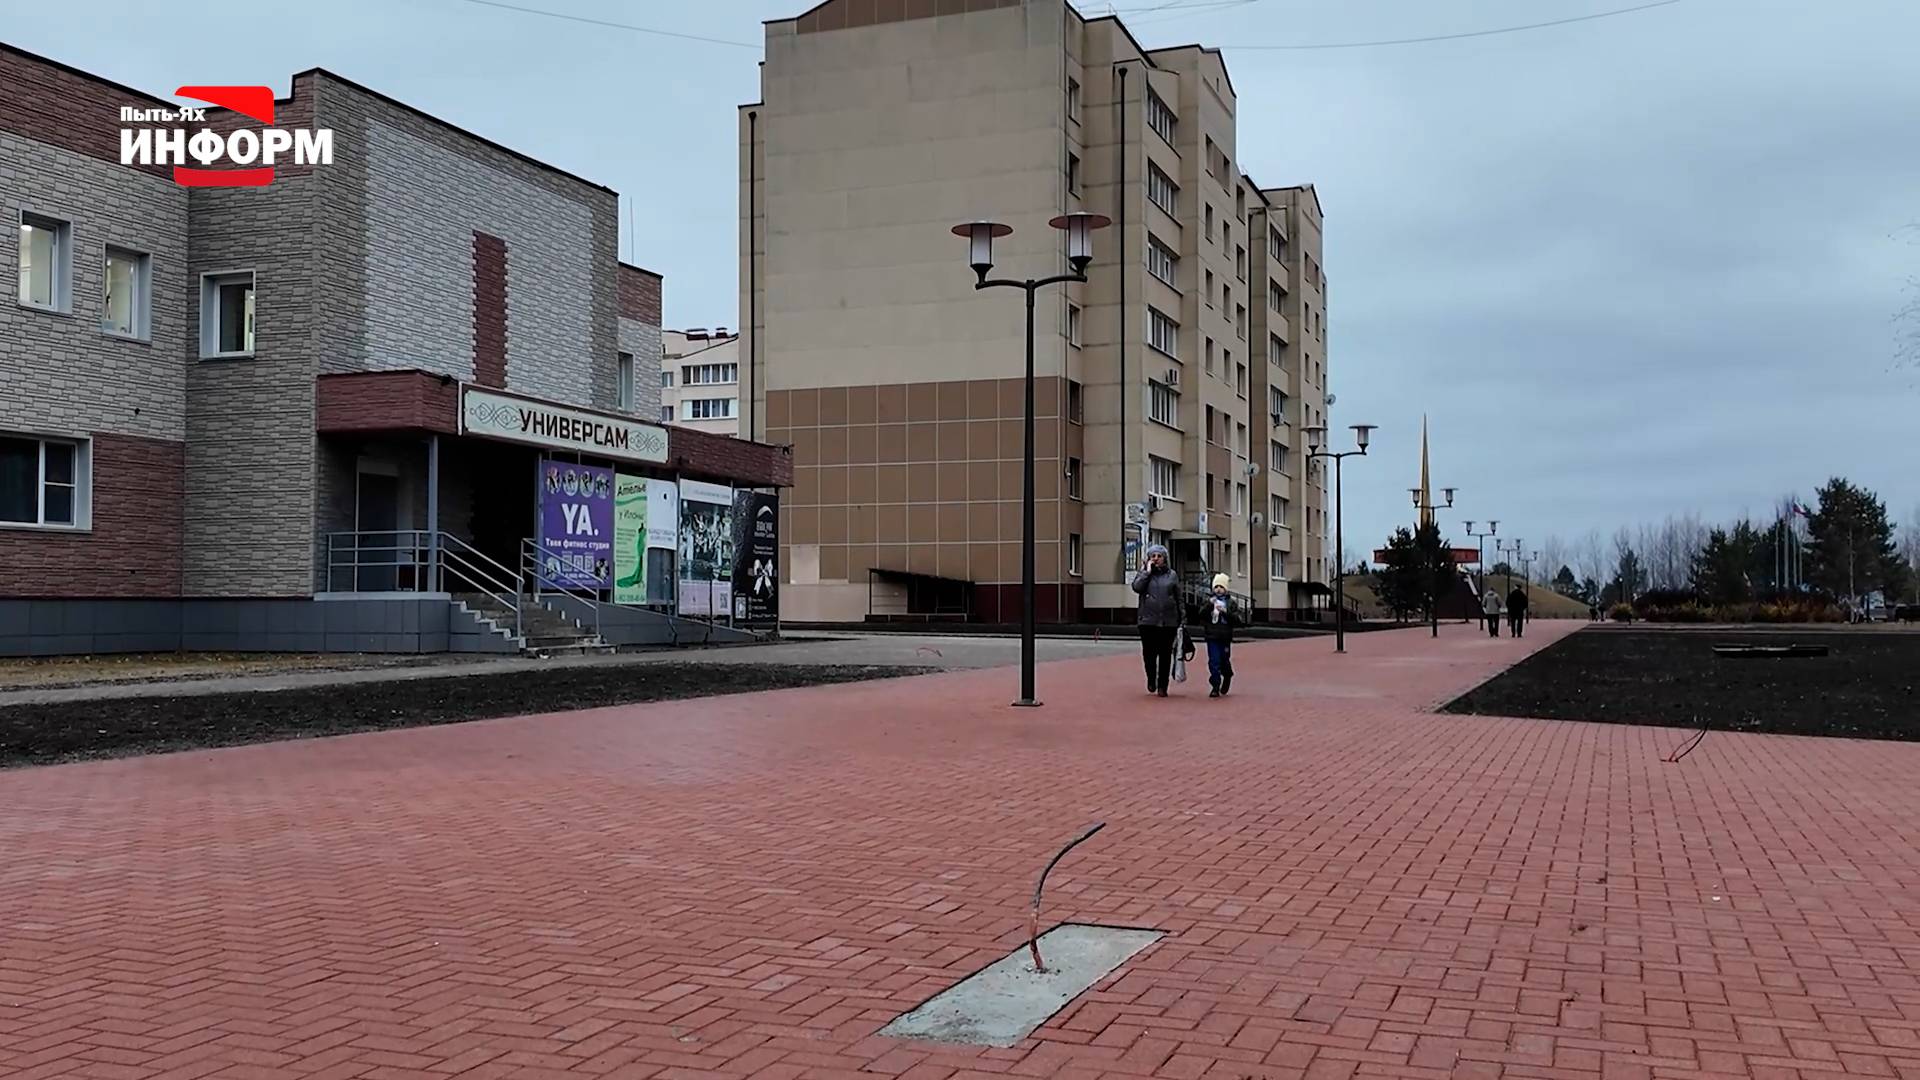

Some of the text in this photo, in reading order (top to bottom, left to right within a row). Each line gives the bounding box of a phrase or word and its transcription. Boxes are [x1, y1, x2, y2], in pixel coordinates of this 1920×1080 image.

[519, 408, 629, 449] УНИВЕРСАМ
[545, 537, 610, 551] Твоя фитнес студия
